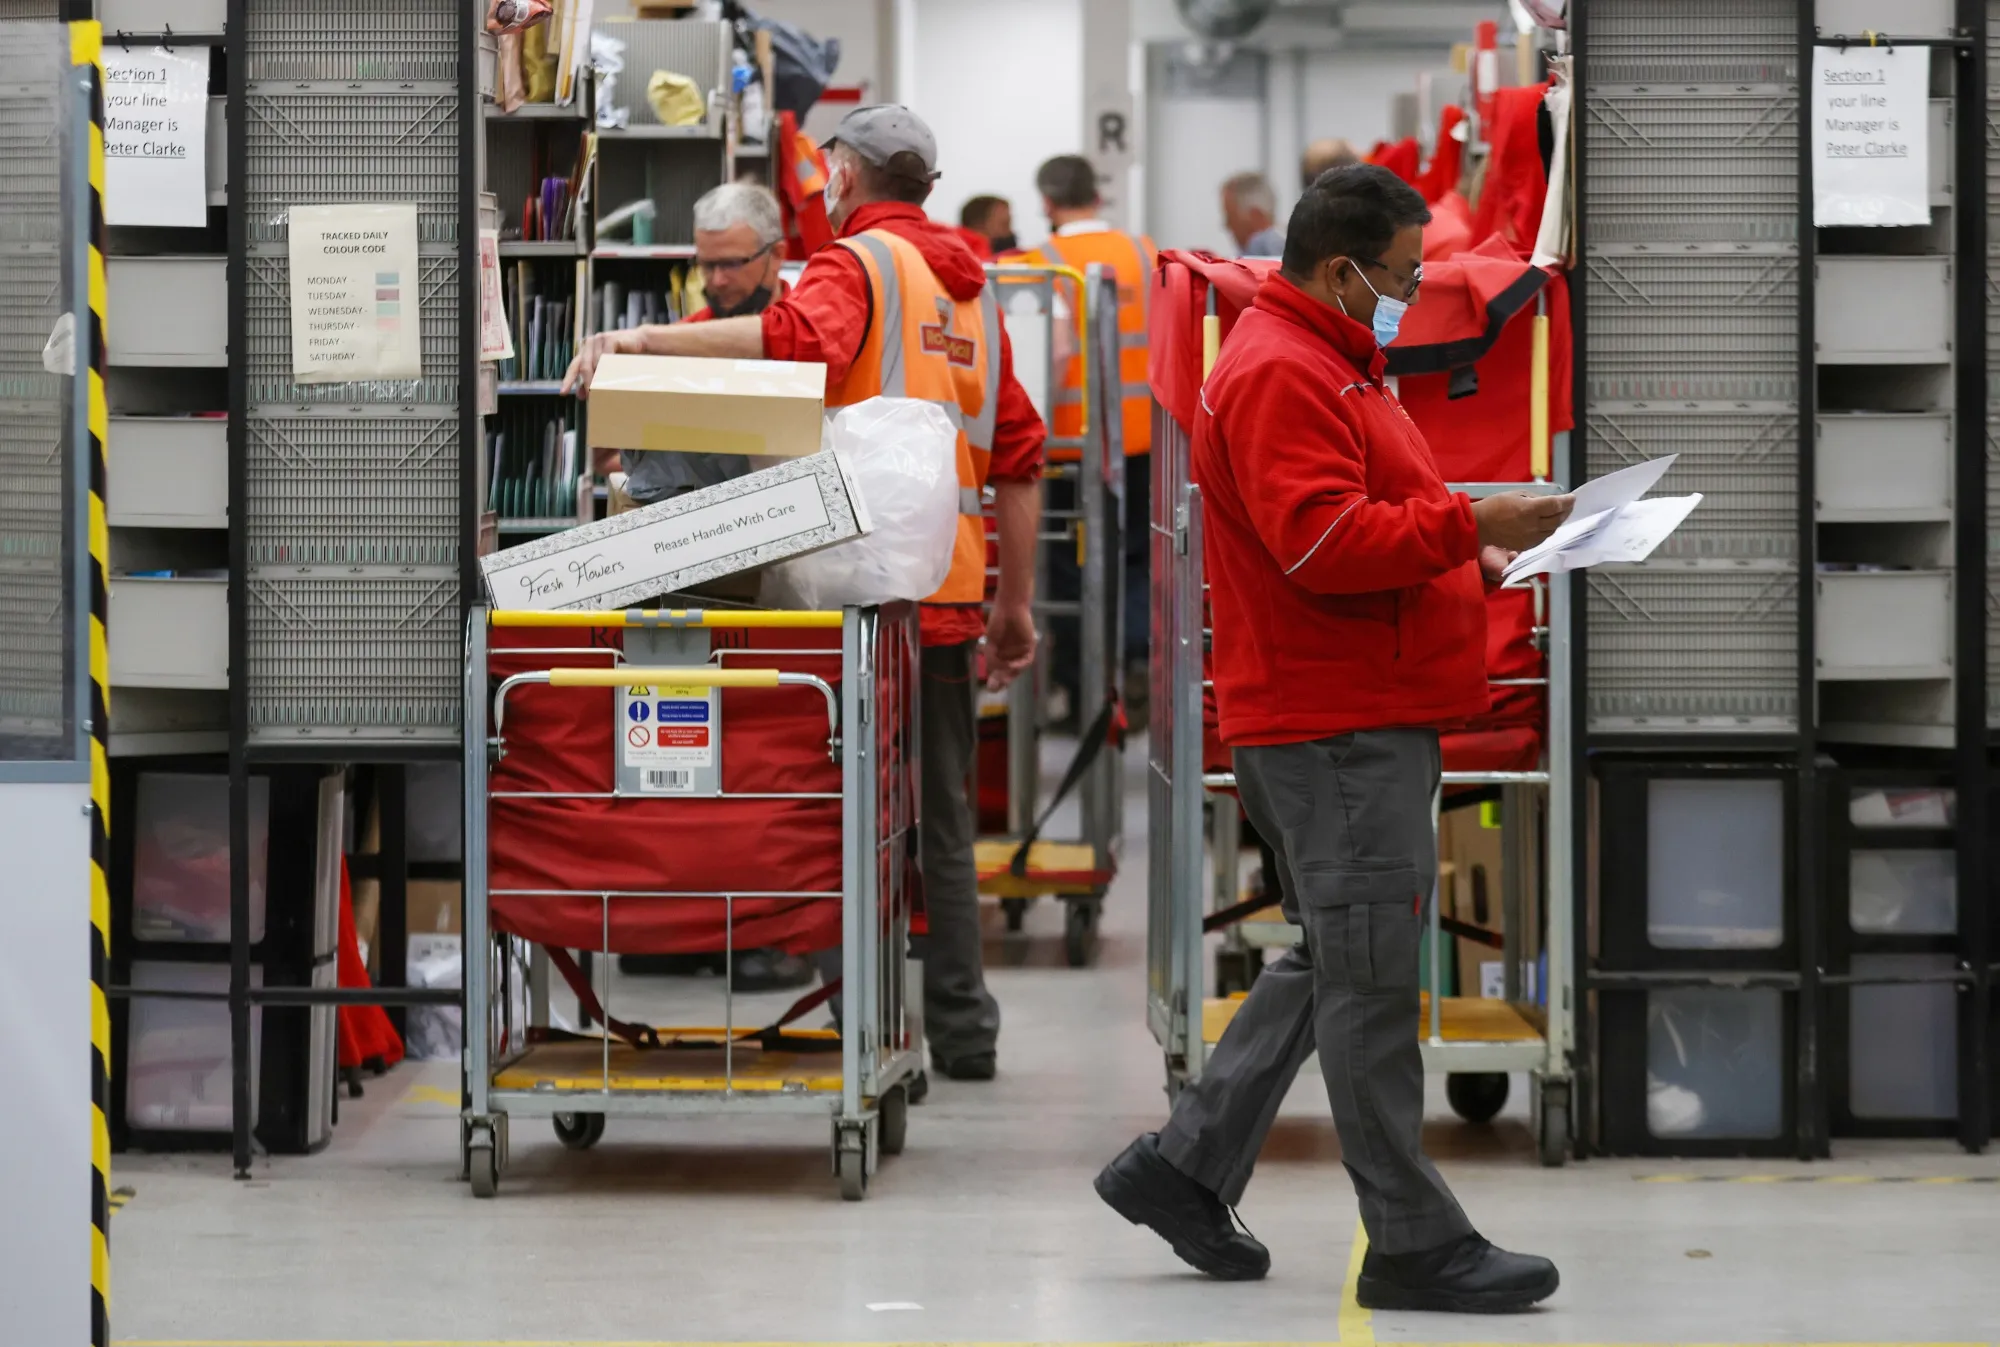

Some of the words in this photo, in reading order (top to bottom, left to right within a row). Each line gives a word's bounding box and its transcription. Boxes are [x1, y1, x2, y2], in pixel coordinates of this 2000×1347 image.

[106, 67, 155, 81] Section
[160, 68, 167, 81] 1
[1823, 69, 1872, 82] Section
[1877, 69, 1885, 82] 1
[107, 95, 138, 108] your
[142, 93, 167, 107] line
[1828, 97, 1857, 110] your
[1860, 94, 1887, 107] line
[104, 117, 164, 134] Manager
[168, 118, 178, 131] is
[1825, 119, 1885, 134] Manager
[1888, 117, 1899, 131] is
[142, 142, 186, 156] Clarke
[1826, 142, 1861, 155] Peter
[1864, 141, 1908, 155] Clarke
[321, 232, 361, 241] TRACKED
[362, 231, 389, 240] DAILY
[323, 246, 360, 255] COLOUR
[362, 245, 386, 254] CODE
[307, 276, 347, 286] MONDAY
[308, 292, 347, 301] TUESDAY
[308, 307, 363, 316] WEDNESDAY
[309, 322, 355, 332] THURSDAY
[309, 338, 340, 347] FRIDAY
[310, 352, 355, 362] SATURDAY
[654, 537, 690, 554] Please
[692, 522, 733, 542] Handle
[733, 512, 765, 528] With
[767, 504, 796, 519] Care
[520, 568, 564, 602] Fresh
[568, 553, 625, 588] Flowers
